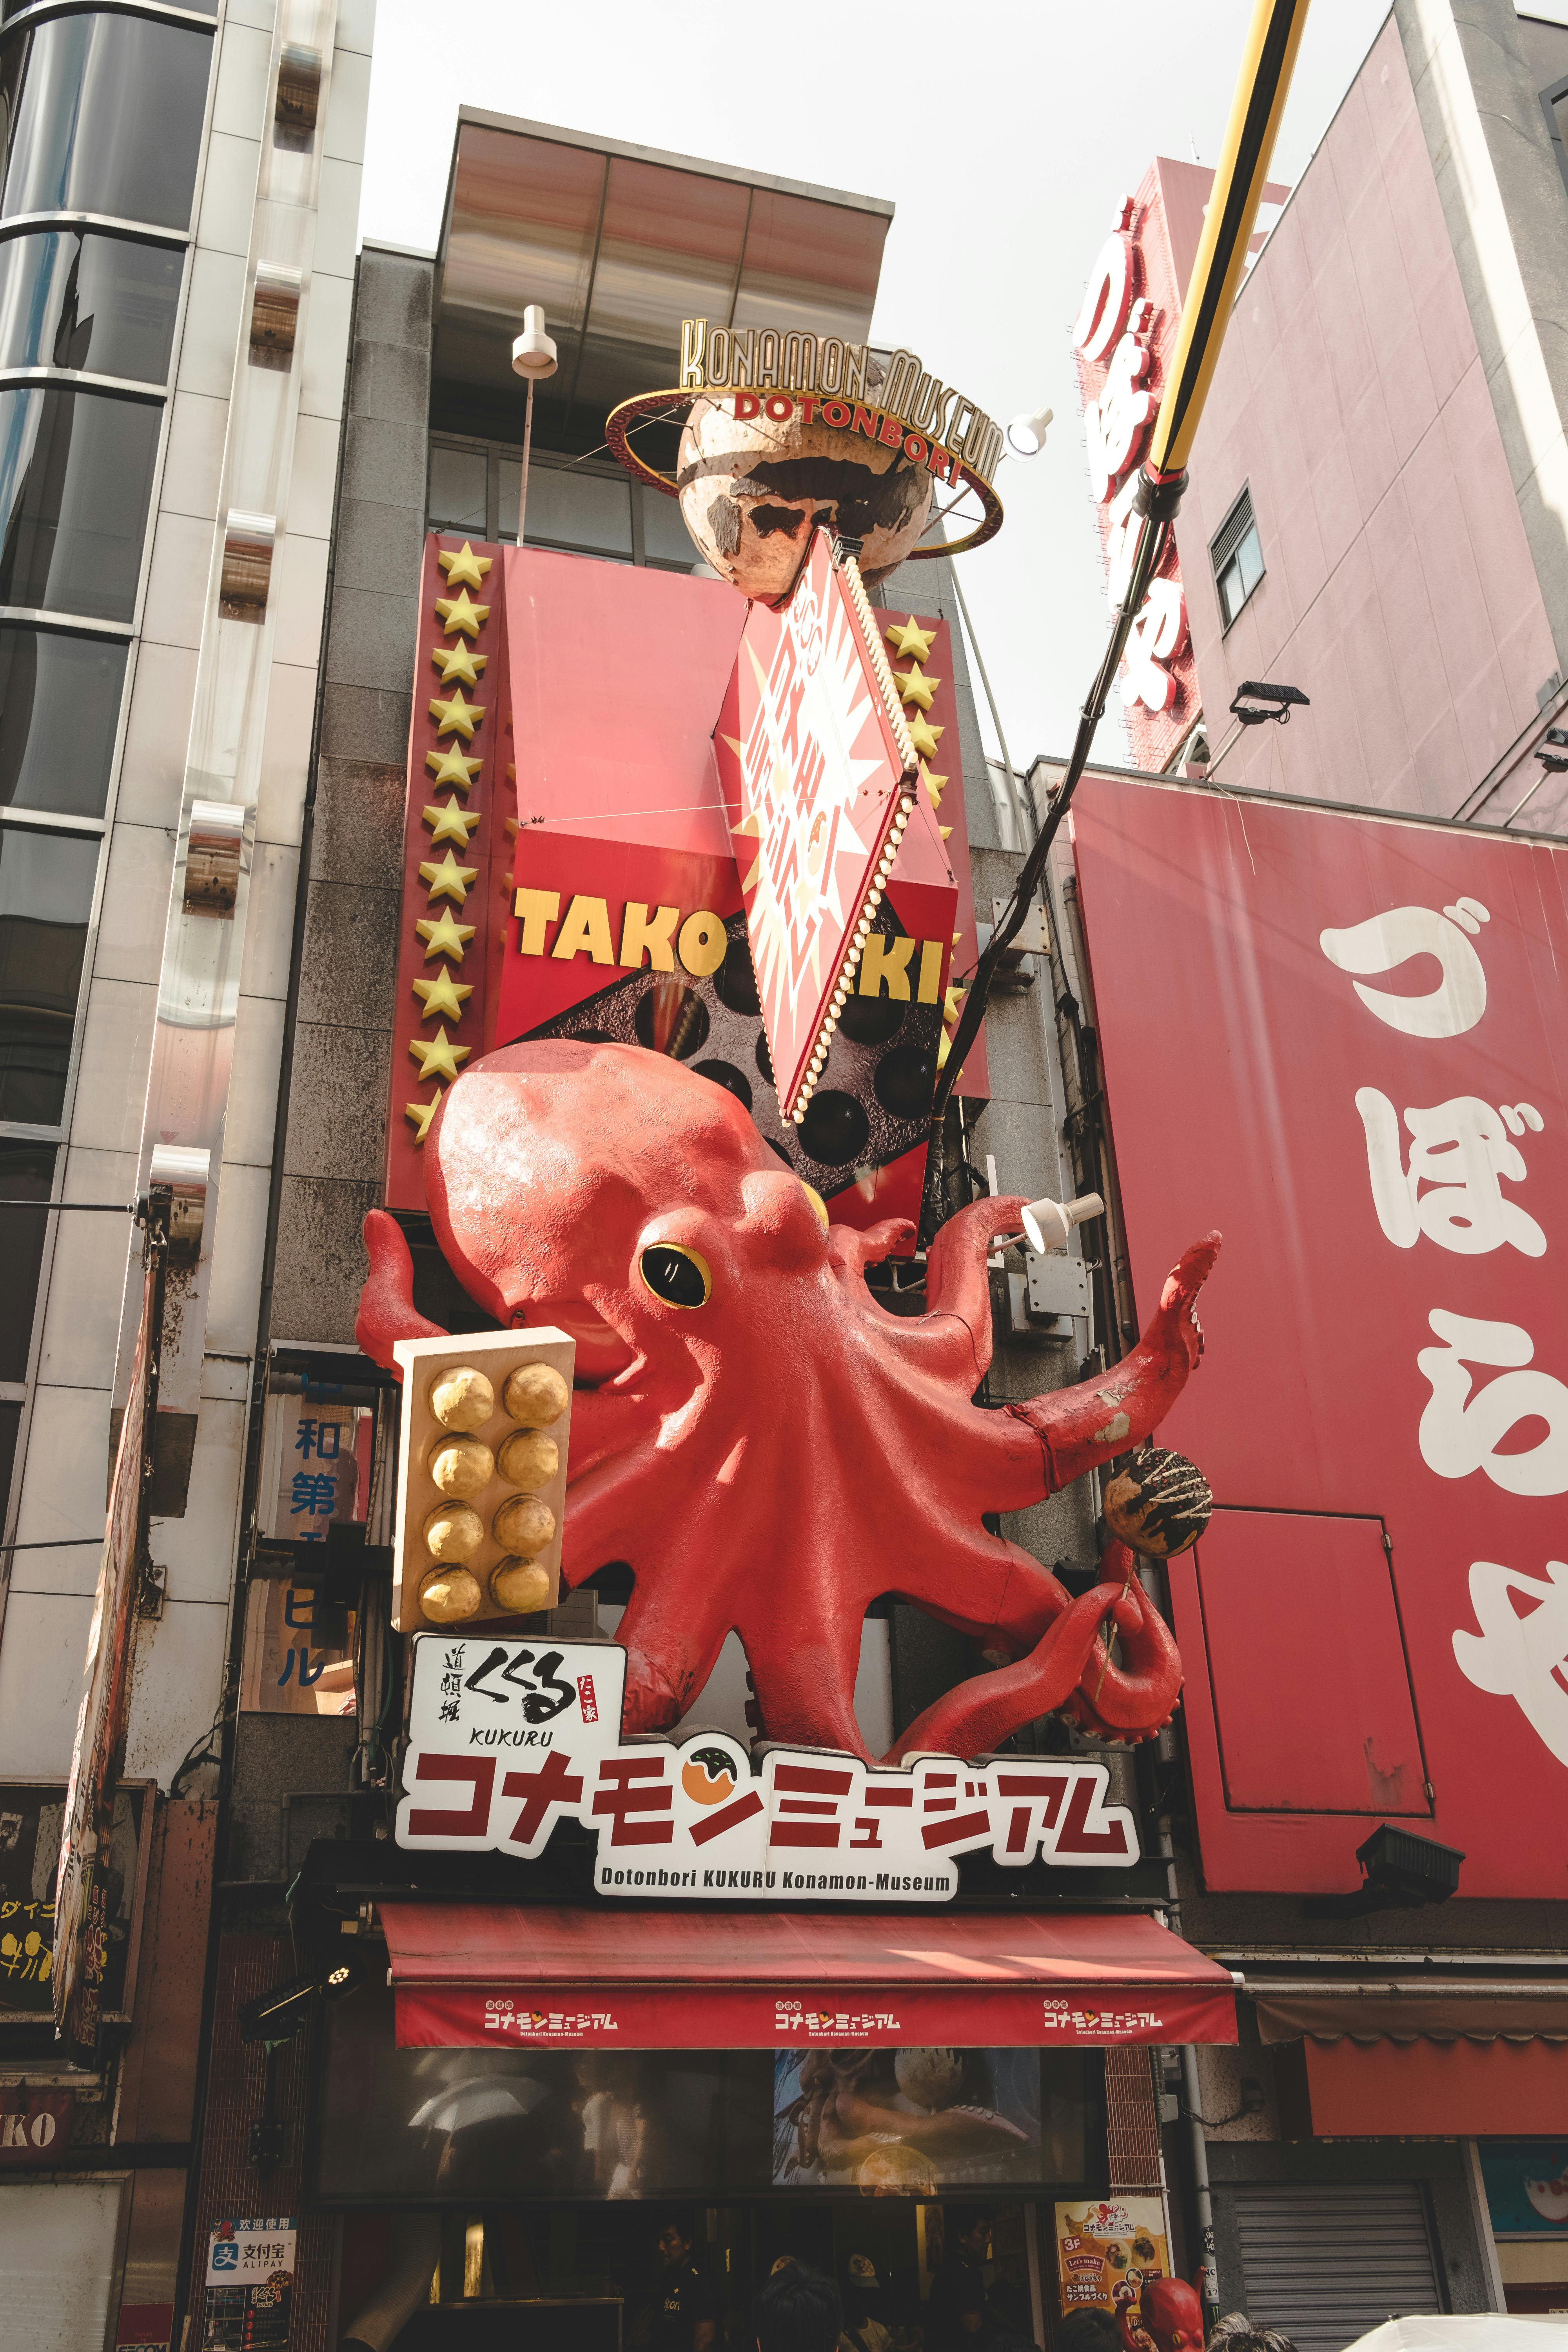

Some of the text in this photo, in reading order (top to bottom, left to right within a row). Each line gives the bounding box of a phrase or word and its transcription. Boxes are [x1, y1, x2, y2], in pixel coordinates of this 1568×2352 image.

[732, 392, 964, 490] DOTONBORI
[514, 887, 944, 1004] TAKOKI
[438, 1642, 467, 1724] 道頓堀
[464, 1646, 576, 1724] くくる
[579, 1677, 598, 1722] たこ家
[469, 1727, 554, 1747] KUKURU
[408, 1748, 1129, 1855] コナモンミュージアム
[601, 1867, 950, 1891] Dotonbori KUKURU Konamon-Museum
[485, 2011, 618, 2029] コナモンミュージアム
[775, 2012, 901, 2030] コナモンミュージアム
[1044, 2010, 1163, 2028] コナモンミュージアム
[0, 2113, 56, 2147] KO
[239, 2218, 290, 2230] 欢迎使用
[242, 2243, 285, 2260] 支付宝
[1064, 2238, 1081, 2251] 3F
[243, 2260, 283, 2269] ALIPAY
[1069, 2258, 1083, 2266] Let's
